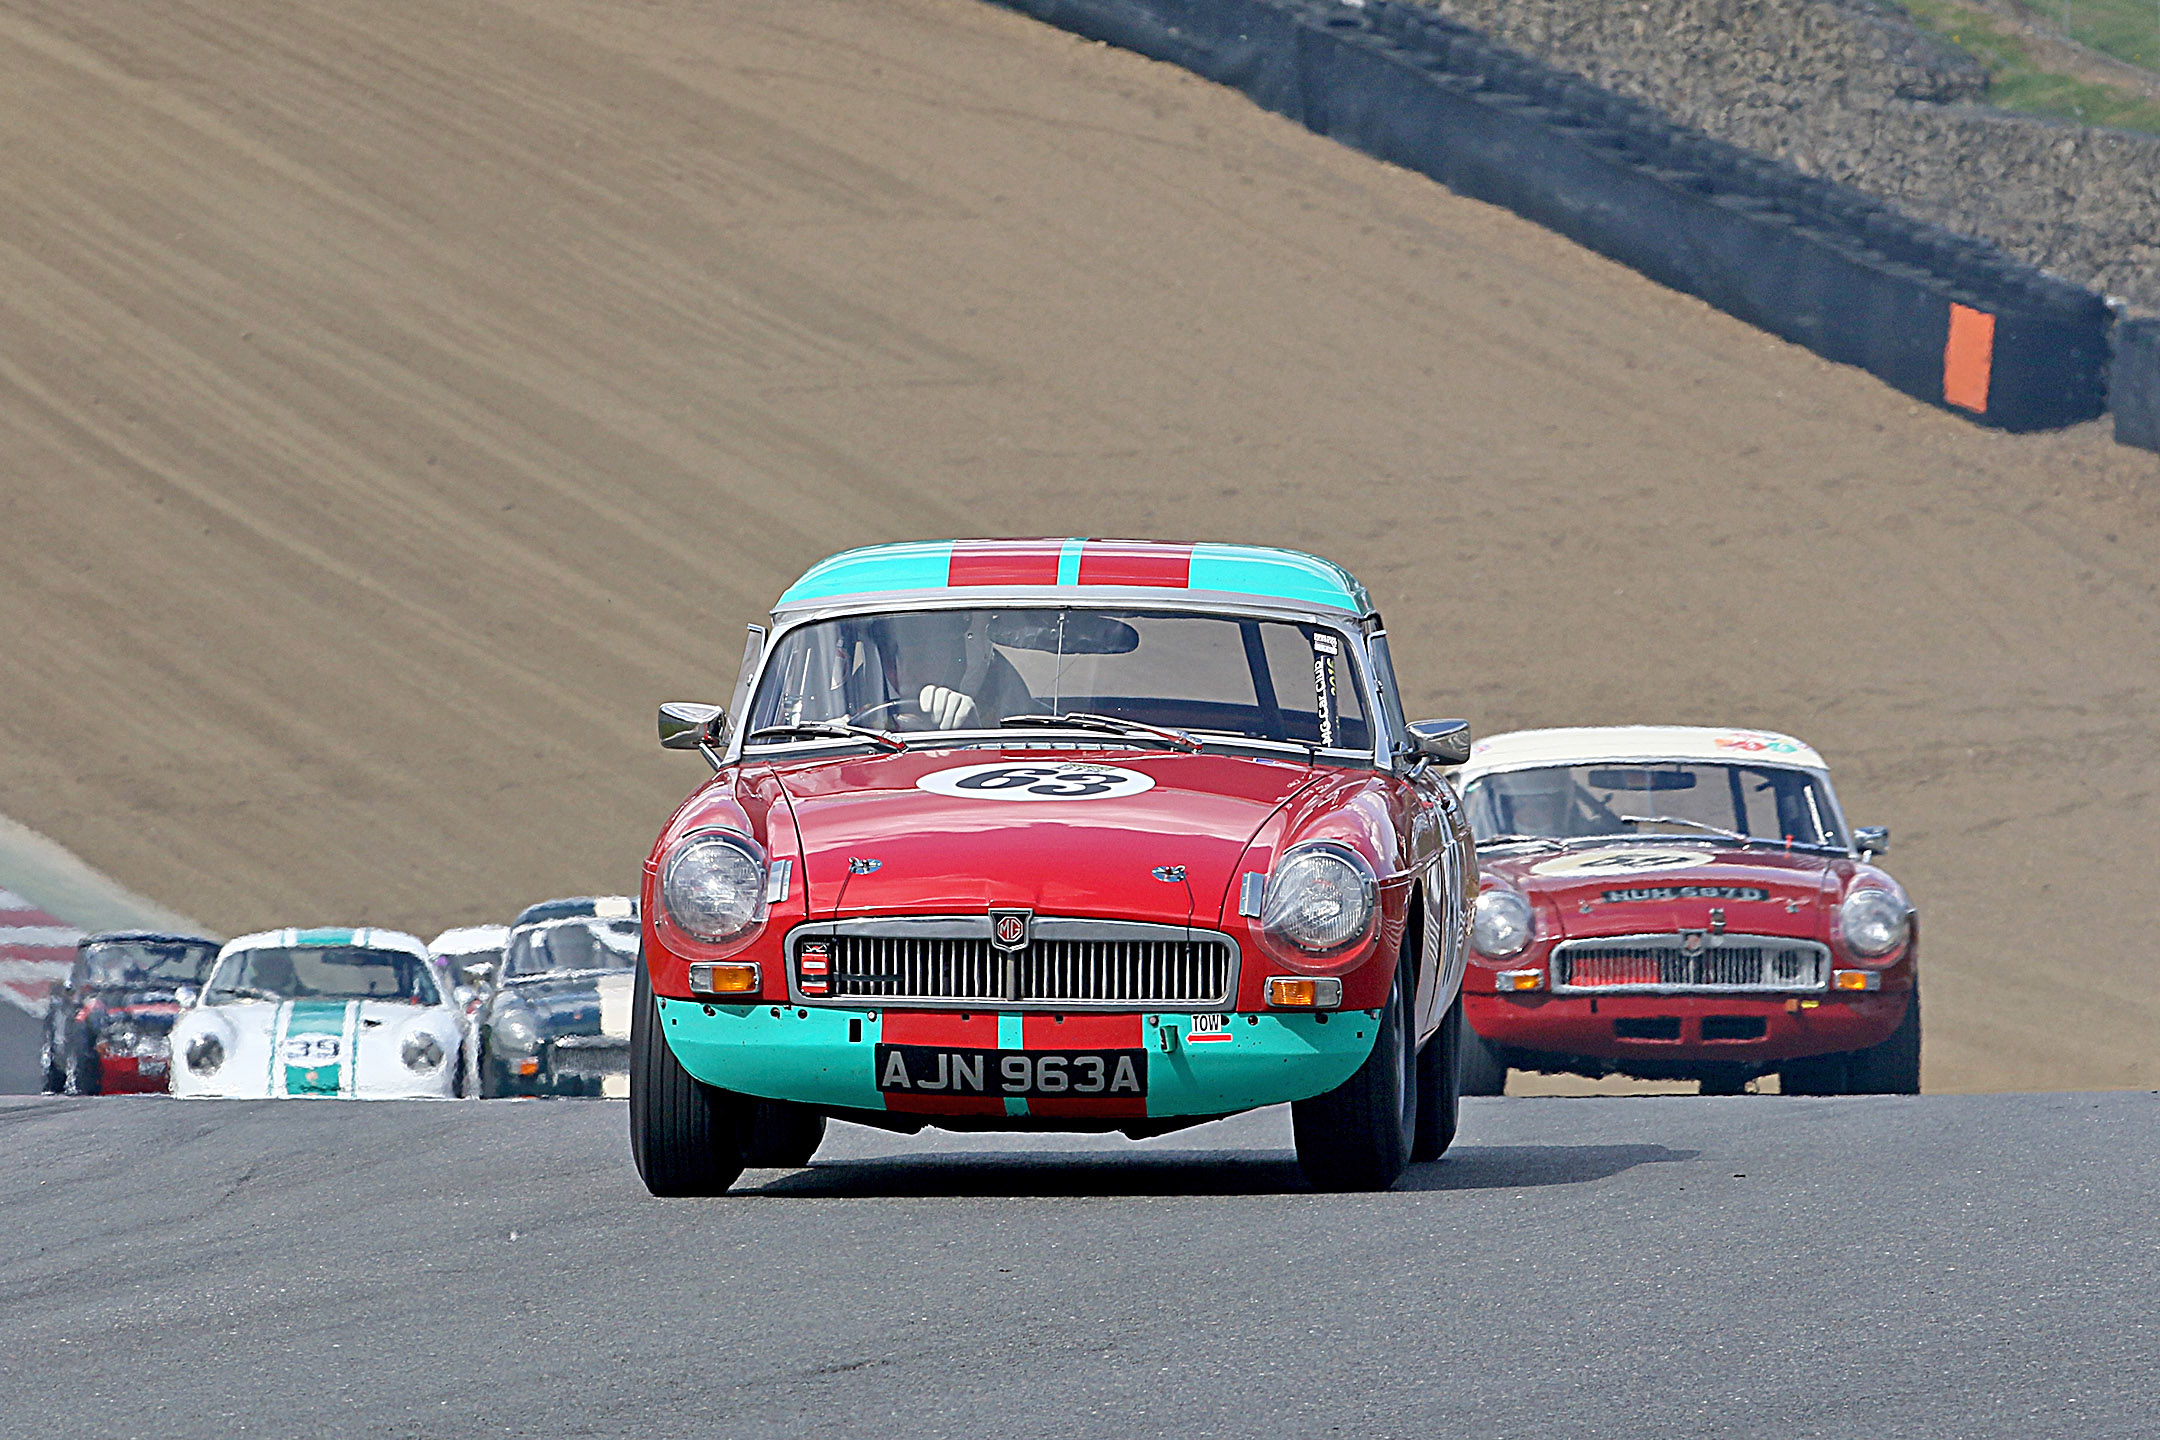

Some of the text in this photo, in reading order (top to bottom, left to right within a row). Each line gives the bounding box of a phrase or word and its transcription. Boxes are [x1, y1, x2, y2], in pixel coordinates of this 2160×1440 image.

[1314, 656, 1326, 692] Club
[1318, 692, 1328, 719] Car
[1320, 720, 1333, 747] MG
[955, 767, 1128, 796] 63
[1608, 887, 1674, 902] HUH
[1000, 919, 1021, 939] MG
[1192, 1014, 1220, 1032] TOW
[287, 1039, 341, 1059] 39
[881, 1050, 1140, 1093] AJN 963A
